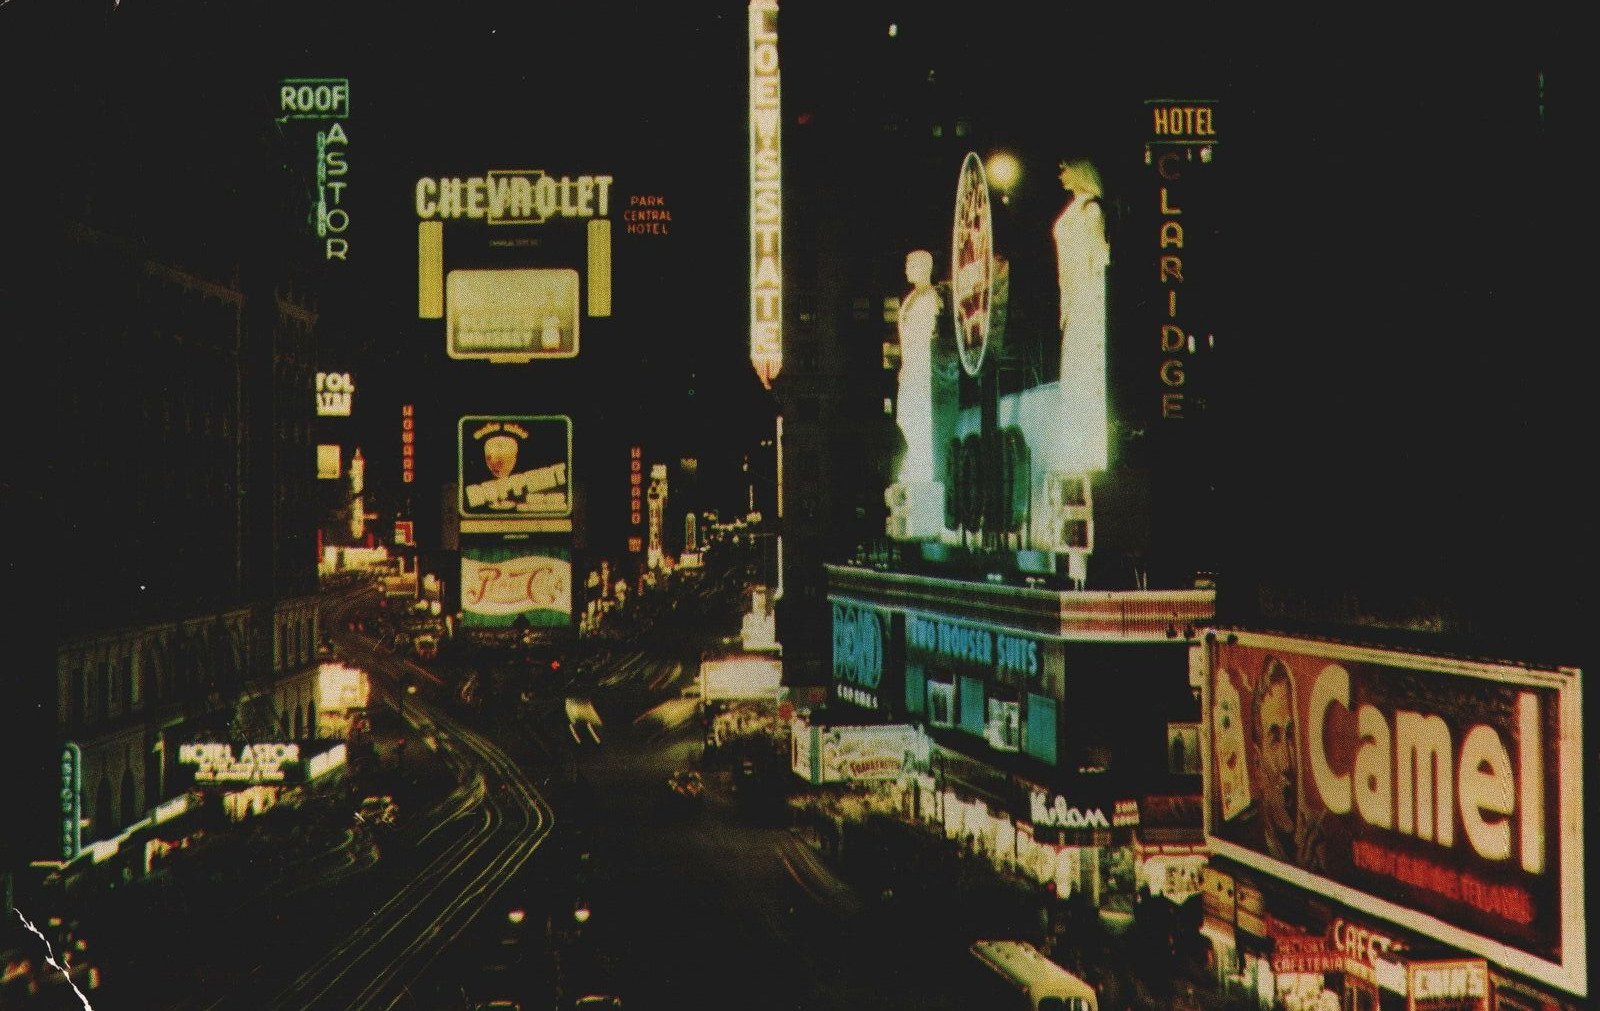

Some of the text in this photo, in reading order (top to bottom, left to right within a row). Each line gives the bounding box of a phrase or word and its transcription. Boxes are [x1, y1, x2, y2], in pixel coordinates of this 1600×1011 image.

[281, 85, 346, 111] ROOF
[1154, 107, 1215, 135] HOTEL
[326, 122, 349, 260] ASTOR
[415, 175, 613, 218] CHEVROLET
[630, 195, 665, 207] PARK
[623, 209, 672, 222] CENTRAL
[627, 223, 669, 235] HOTEL
[754, 188, 781, 357] STATE
[1158, 152, 1185, 418] CLARIDGE
[997, 632, 1038, 676] SUITS
[1308, 664, 1545, 876] Camel
